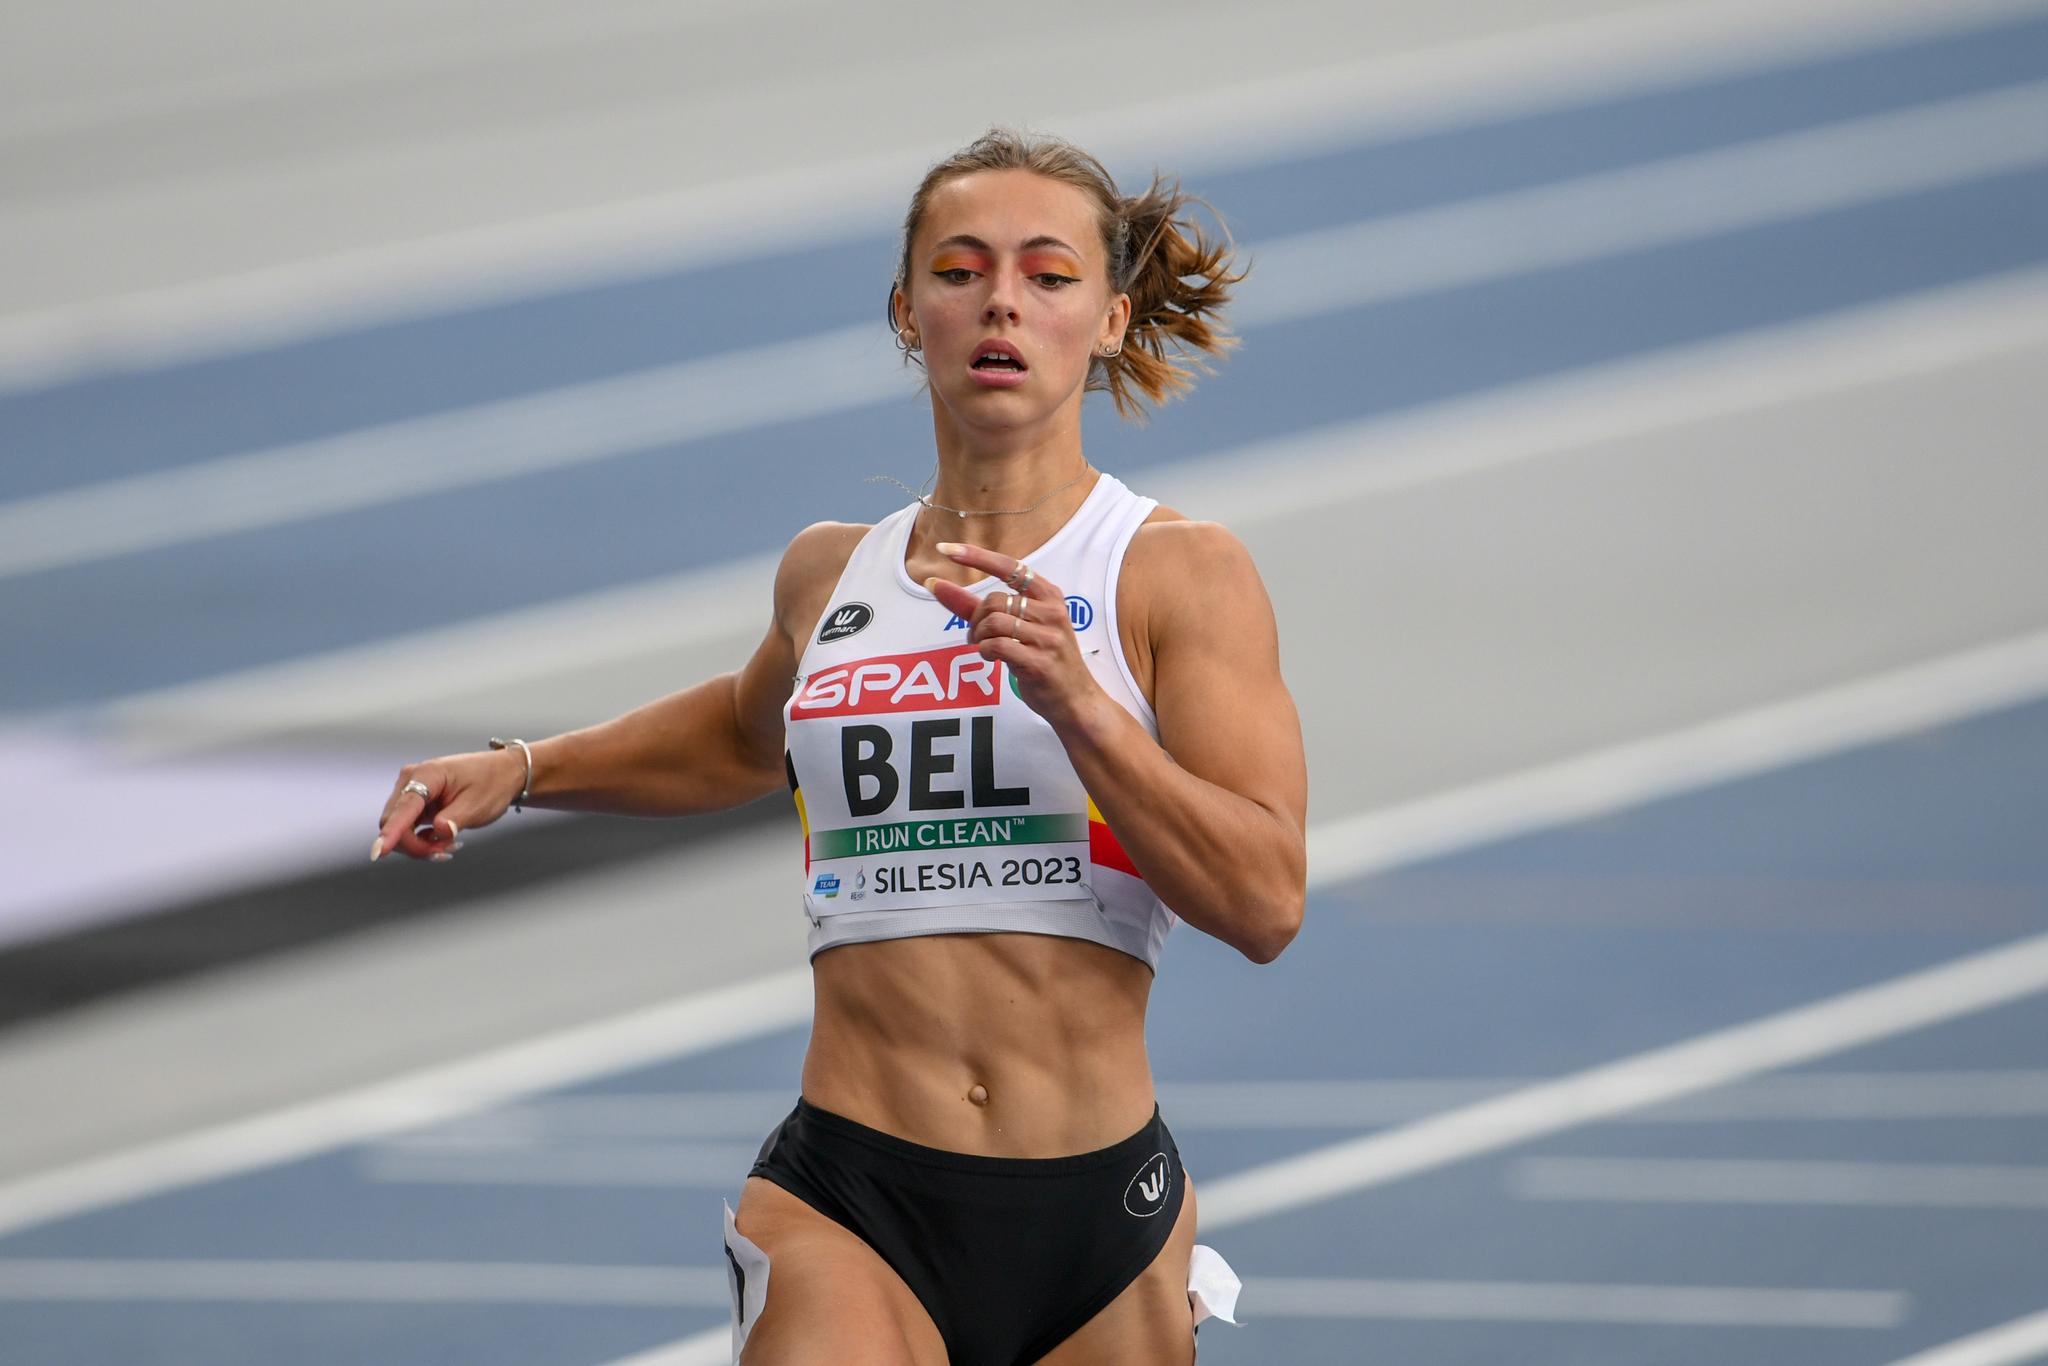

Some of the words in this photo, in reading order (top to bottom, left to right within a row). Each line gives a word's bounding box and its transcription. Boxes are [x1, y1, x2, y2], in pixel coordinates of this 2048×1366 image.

[822, 625, 857, 638] vermarc
[799, 652, 995, 709] SPAR
[841, 716, 1030, 817] BEL
[856, 831, 861, 852] I
[866, 825, 909, 851] RUN
[820, 880, 837, 889] TEAM
[874, 861, 993, 894] SILESIA
[1001, 857, 1082, 886] 2023
